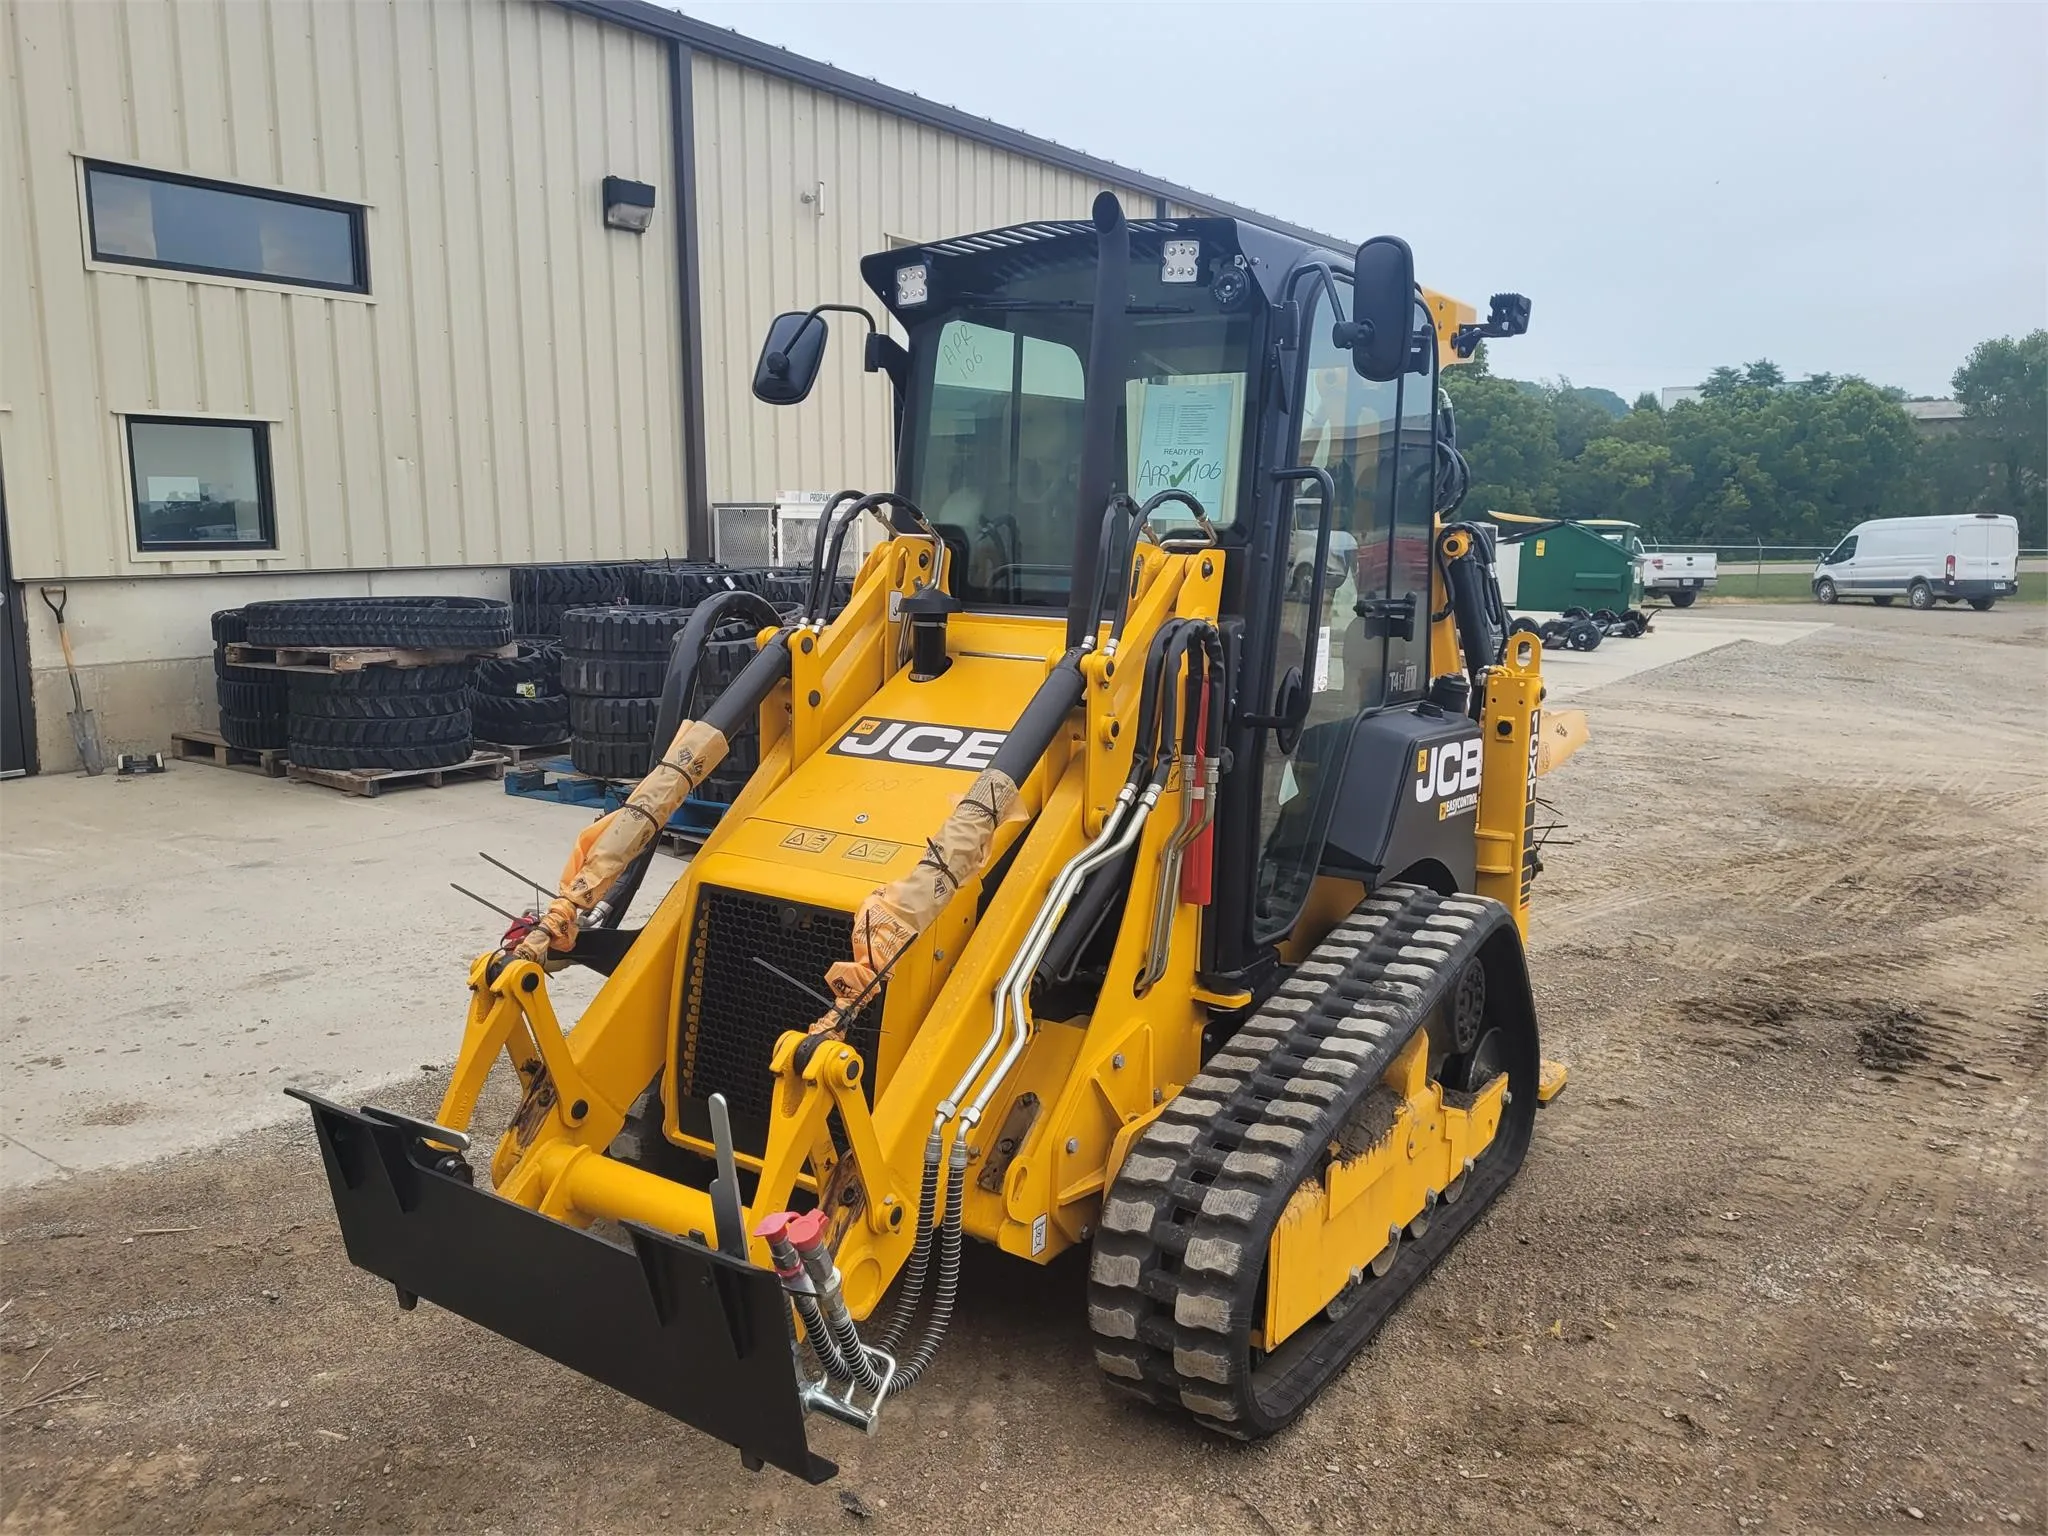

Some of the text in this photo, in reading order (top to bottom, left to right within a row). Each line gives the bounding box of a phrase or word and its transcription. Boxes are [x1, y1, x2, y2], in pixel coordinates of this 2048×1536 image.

[943, 324, 973, 366] APR
[960, 350, 983, 379] 106
[1163, 448, 1204, 456] READY FOR
[1138, 459, 1170, 488] APR
[1415, 737, 1483, 803] JCB
